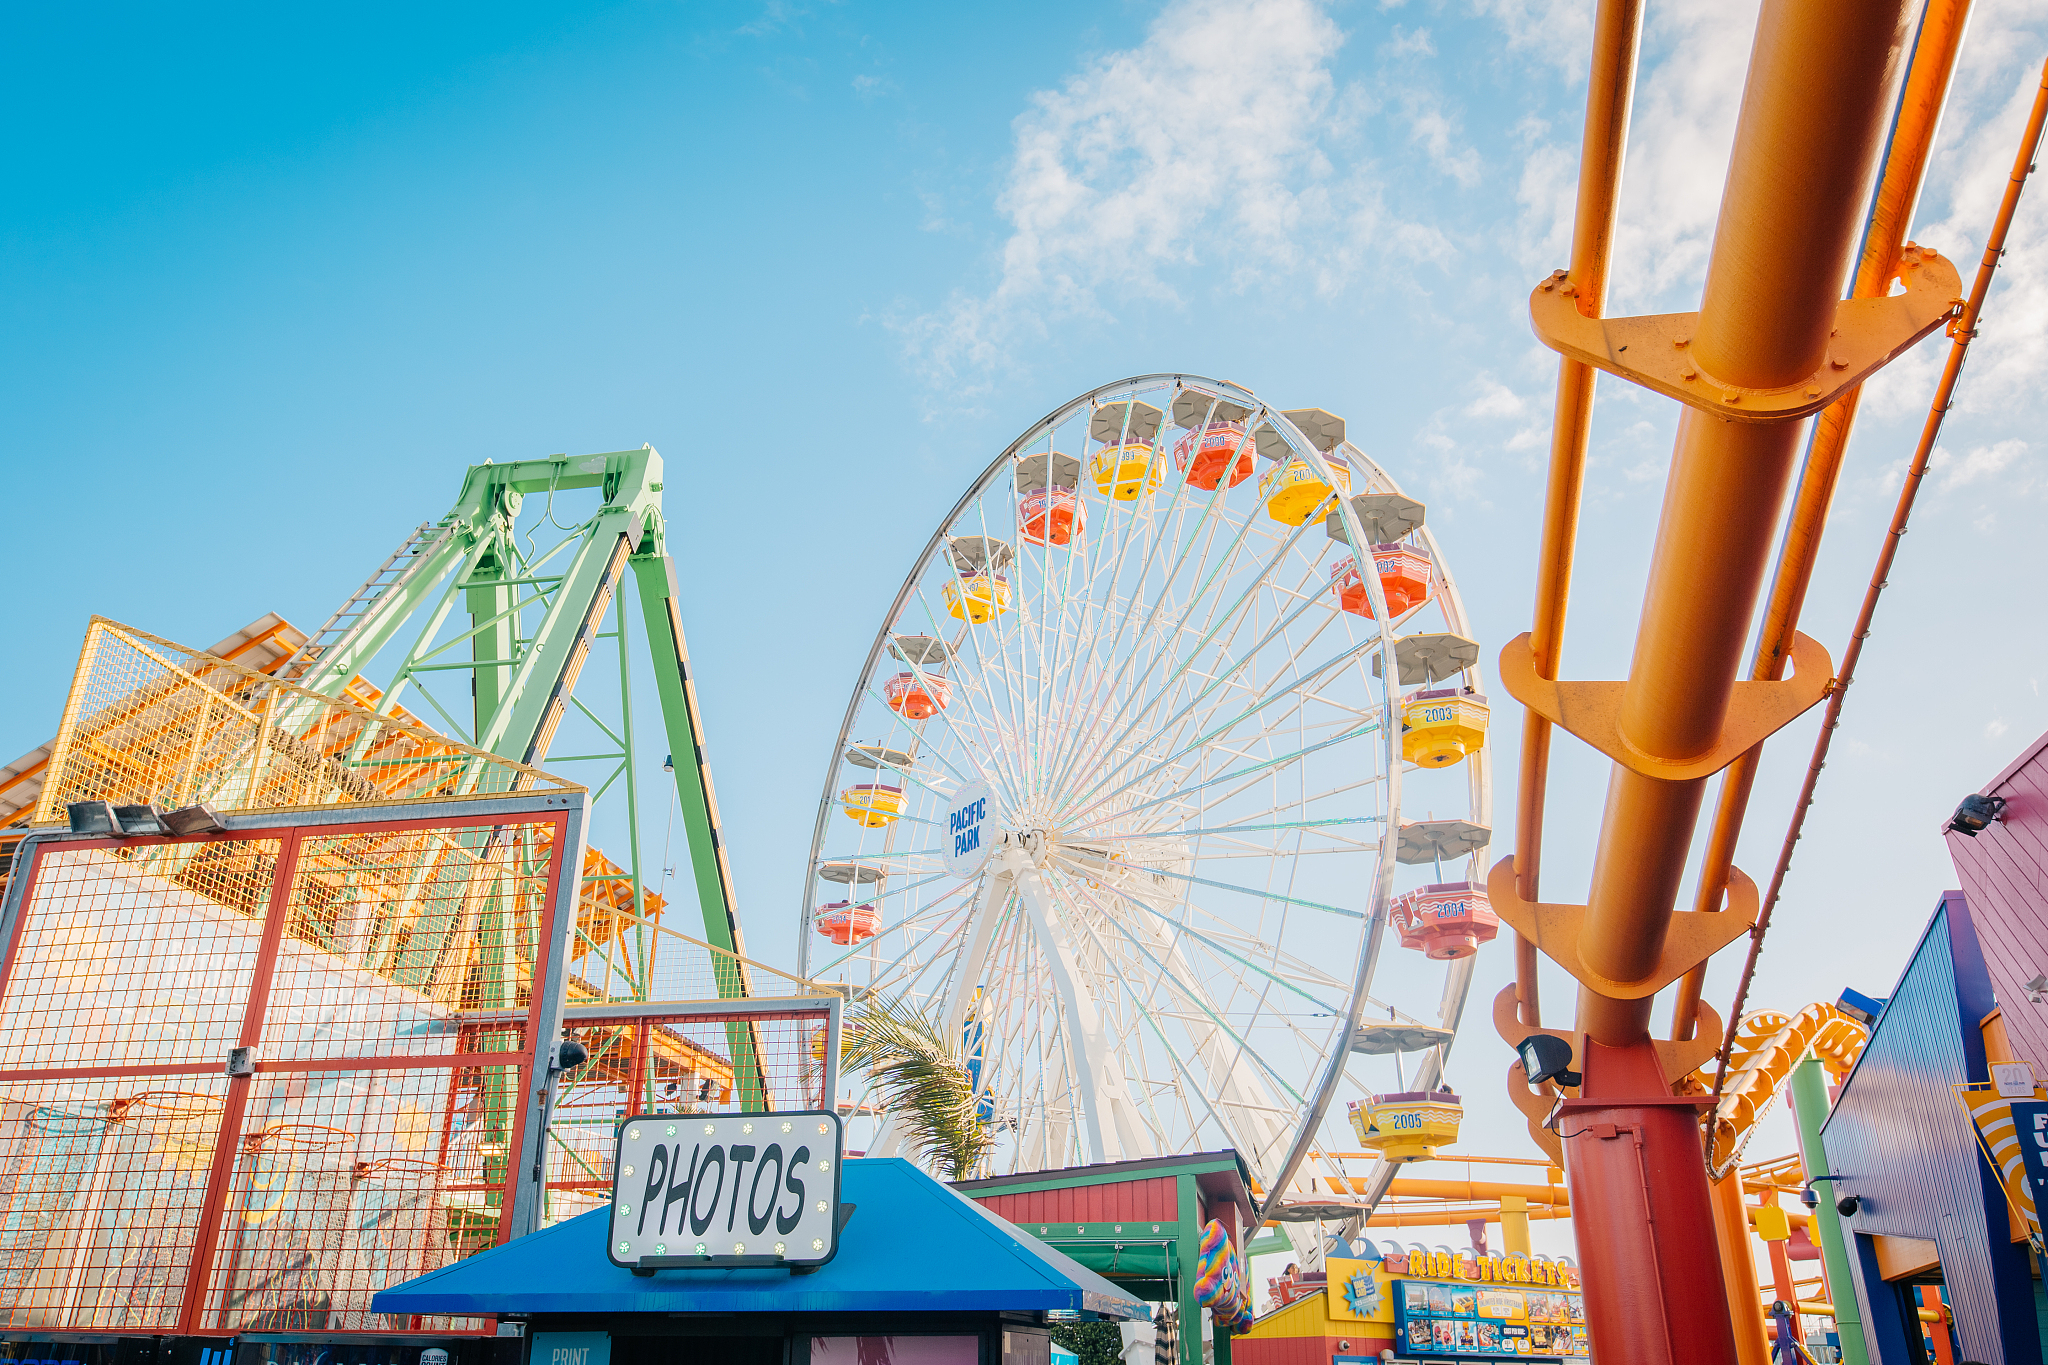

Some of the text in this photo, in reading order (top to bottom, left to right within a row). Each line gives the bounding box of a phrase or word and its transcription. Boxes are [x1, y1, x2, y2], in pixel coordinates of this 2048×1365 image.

[1204, 436, 1225, 448] 2000
[1293, 468, 1315, 482] 2001
[1376, 560, 1396, 573] 002
[1425, 707, 1453, 722] 2003
[950, 797, 986, 835] PACIFIC
[955, 825, 980, 858] PARK
[1436, 902, 1465, 918] 2004
[831, 915, 847, 924] 2014
[2001, 1067, 2024, 1082] 20
[2006, 1086, 2027, 1094] YEARS
[1393, 1114, 1422, 1129] 2005
[637, 1142, 811, 1237] PHOTOS
[1408, 1249, 1569, 1286] RIDE TICKETS
[422, 1354, 447, 1362] CALORIES
[552, 1348, 590, 1365] PRINT
